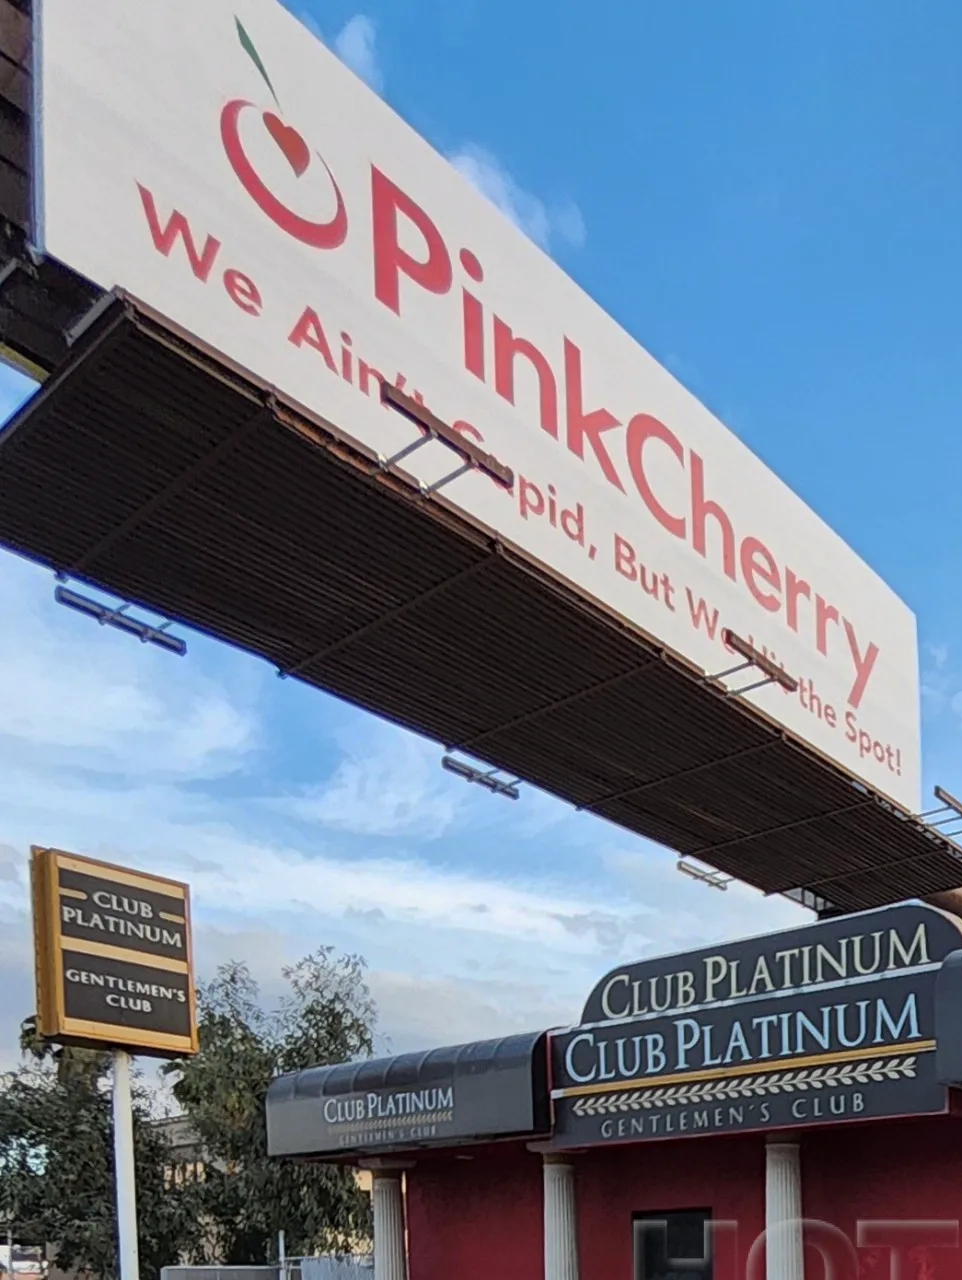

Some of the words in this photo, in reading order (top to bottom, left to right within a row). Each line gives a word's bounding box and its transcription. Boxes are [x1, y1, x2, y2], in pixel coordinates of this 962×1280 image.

[370, 162, 879, 709] PinkCherry
[134, 178, 263, 317] We
[452, 420, 597, 561] pid,
[614, 532, 675, 612] But
[798, 676, 837, 728] the
[845, 711, 902, 776] Spot!
[62, 905, 182, 948] PLATINUM
[92, 891, 153, 918] CLUB
[65, 968, 186, 1002] GENTLEMEN'S
[601, 970, 697, 1019] CLUB
[702, 922, 931, 1002] PLATINUM
[105, 994, 152, 1013] CLUB
[565, 1025, 667, 1083] CLUB
[673, 992, 923, 1070] PLATINUM
[323, 1098, 365, 1123] CLUB
[367, 1086, 454, 1118] PLATINUM
[601, 1101, 771, 1138] GENTLEMEN'S
[791, 1092, 865, 1118] CLUB
